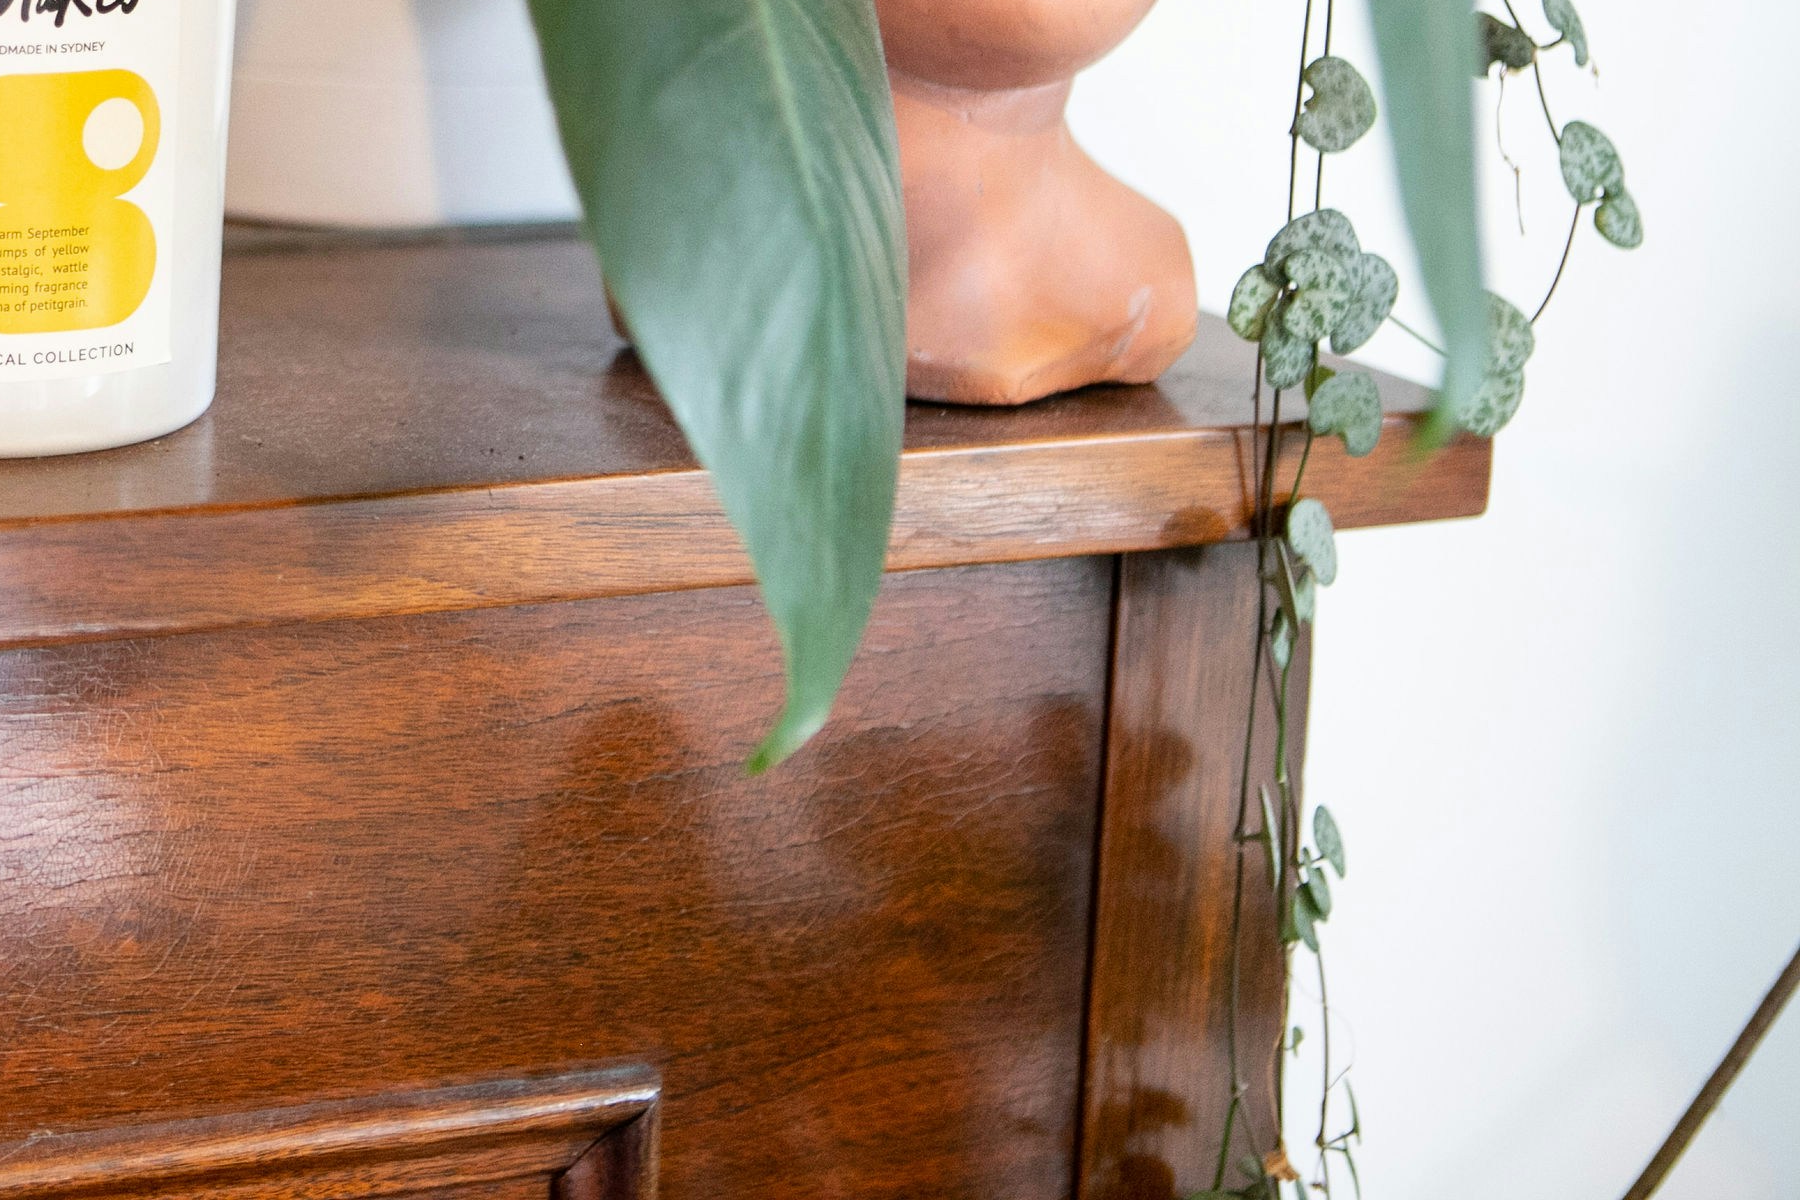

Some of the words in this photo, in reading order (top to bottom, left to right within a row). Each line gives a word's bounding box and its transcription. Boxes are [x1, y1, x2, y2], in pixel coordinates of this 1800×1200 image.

[46, 44, 58, 53] IN
[60, 41, 105, 53] SYDNEY
[27, 226, 90, 242] September
[34, 245, 46, 256] of
[52, 244, 90, 258] yellow
[52, 260, 88, 272] wattle
[34, 280, 88, 296] fragrance
[14, 300, 26, 312] of
[30, 297, 88, 314] petitgrain.
[33, 341, 134, 364] COLLECTION
